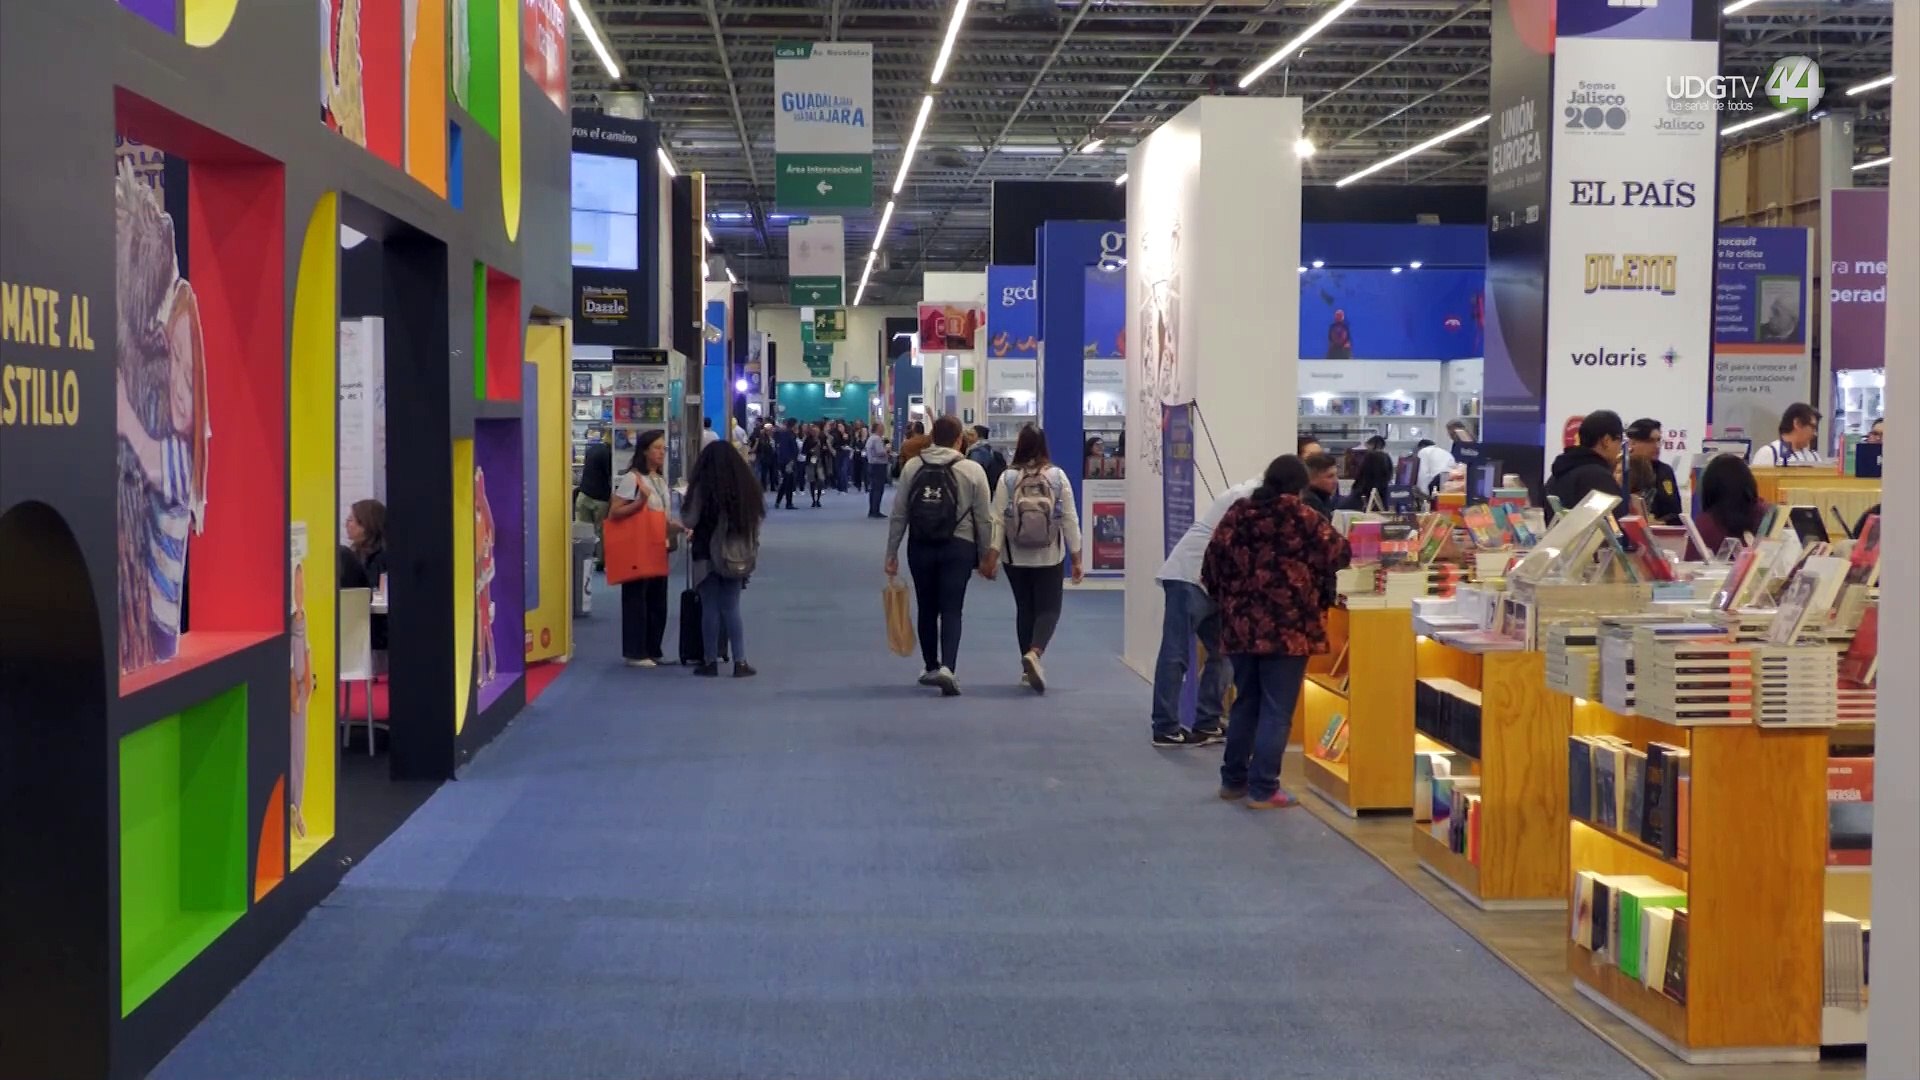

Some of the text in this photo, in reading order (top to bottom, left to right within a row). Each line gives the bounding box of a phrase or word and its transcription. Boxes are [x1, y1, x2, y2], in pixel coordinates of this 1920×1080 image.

[1578, 81, 1616, 90] Somos
[1567, 91, 1626, 106] Jalisco
[1501, 96, 1535, 140] UNIÓN
[1564, 106, 1627, 130] 200
[1654, 117, 1705, 130] Jalisco
[590, 128, 601, 138] el
[601, 130, 638, 144] camino
[1492, 131, 1541, 176] EUROPEA
[786, 164, 863, 175] Área Internacional
[1569, 180, 1616, 206] EL
[1621, 179, 1696, 207] PAÍS
[1855, 261, 1888, 278] me
[1002, 280, 1037, 307] ged
[586, 299, 625, 314] Dazzle
[69, 294, 95, 350] AL
[1571, 347, 1647, 366] volaris
[1730, 364, 1750, 372] para
[1729, 375, 1795, 383] presentaciones
[0, 364, 79, 425] STILLO
[1669, 430, 1687, 438] DE
